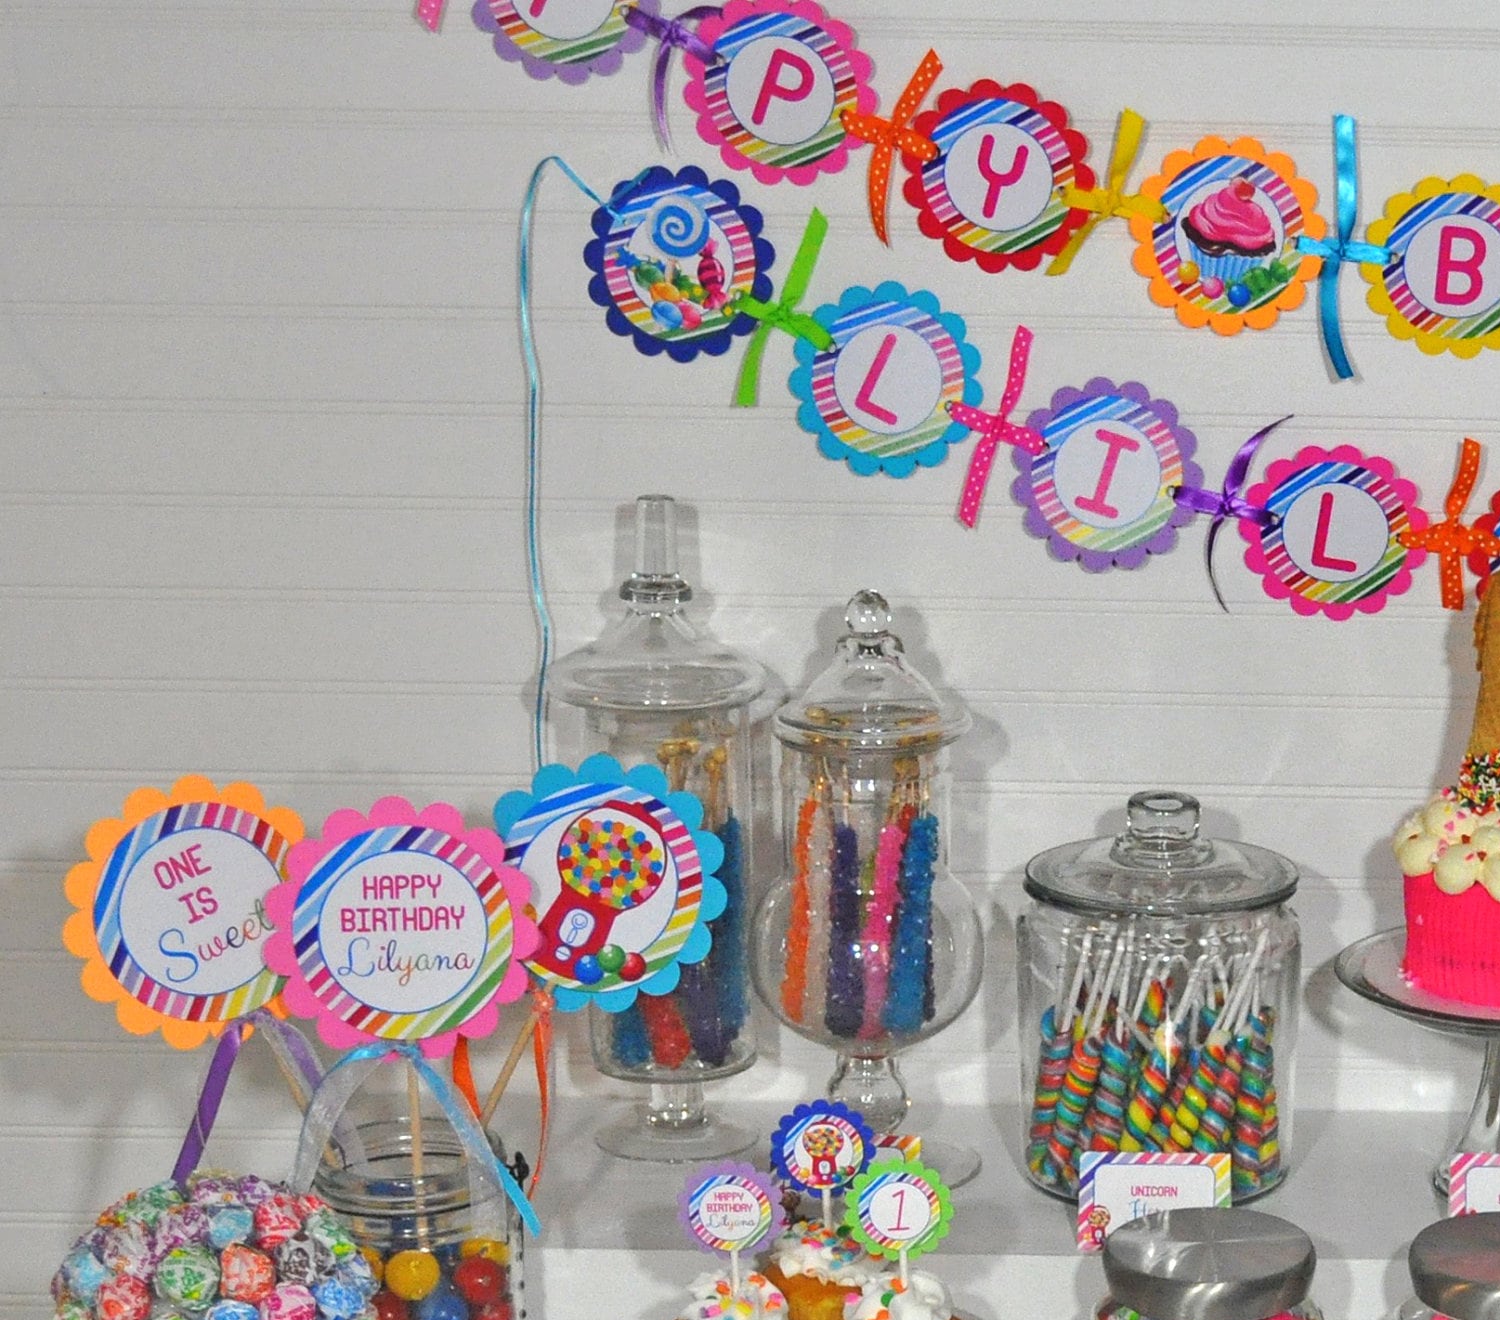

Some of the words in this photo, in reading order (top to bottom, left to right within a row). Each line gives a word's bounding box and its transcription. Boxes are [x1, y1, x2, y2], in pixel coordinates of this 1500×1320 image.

[154, 843, 212, 891] ONE
[362, 875, 442, 901] HAPPY
[177, 886, 219, 923] IS
[340, 907, 466, 932] BIRTHDAY
[337, 937, 475, 986] Lilyana
[713, 1192, 744, 1201] HAPPY
[1131, 1185, 1178, 1197] UNICORN
[706, 1203, 753, 1213] BIRTHDAY
[887, 1189, 910, 1231] 1
